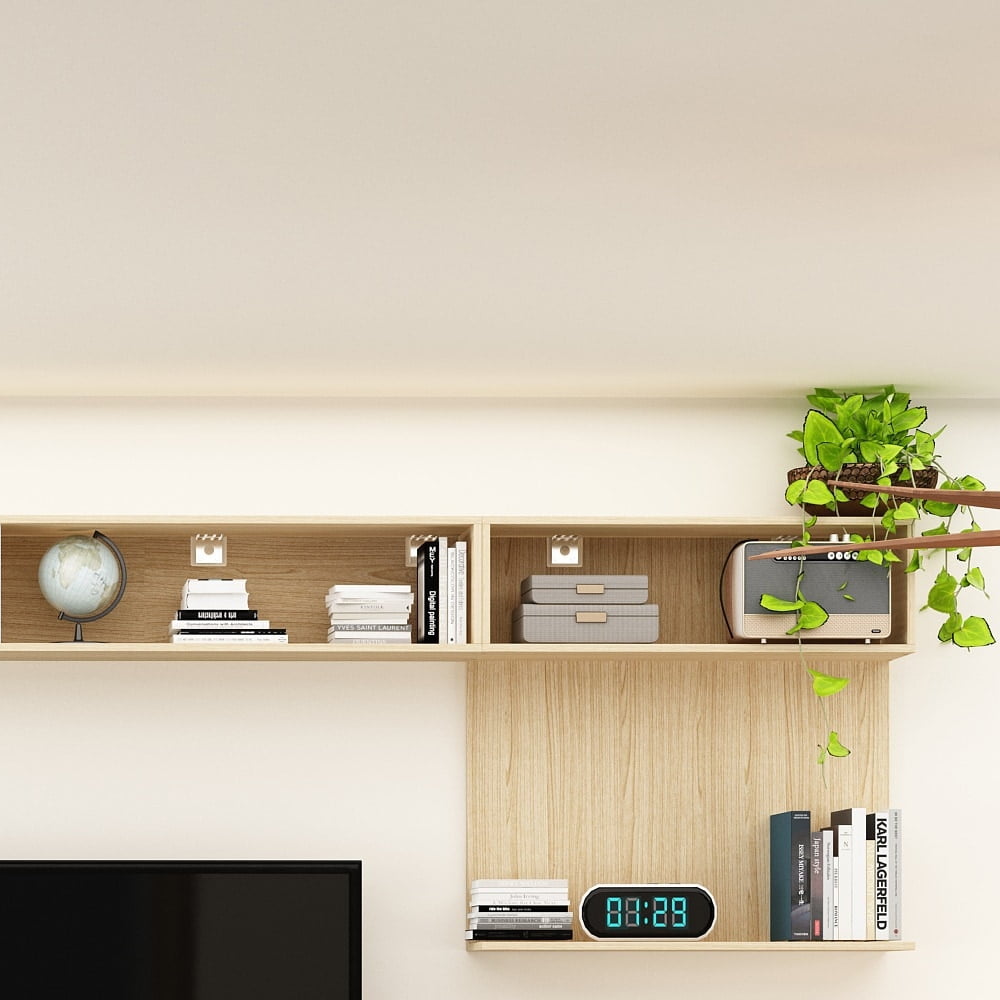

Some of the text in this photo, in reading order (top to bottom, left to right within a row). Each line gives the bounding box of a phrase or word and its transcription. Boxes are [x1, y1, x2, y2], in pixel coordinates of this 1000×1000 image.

[427, 590, 436, 636] Digital painting
[812, 838, 821, 875] Japan style
[876, 818, 887, 930] KARL LAGERFELD
[606, 896, 687, 928] 01:29
